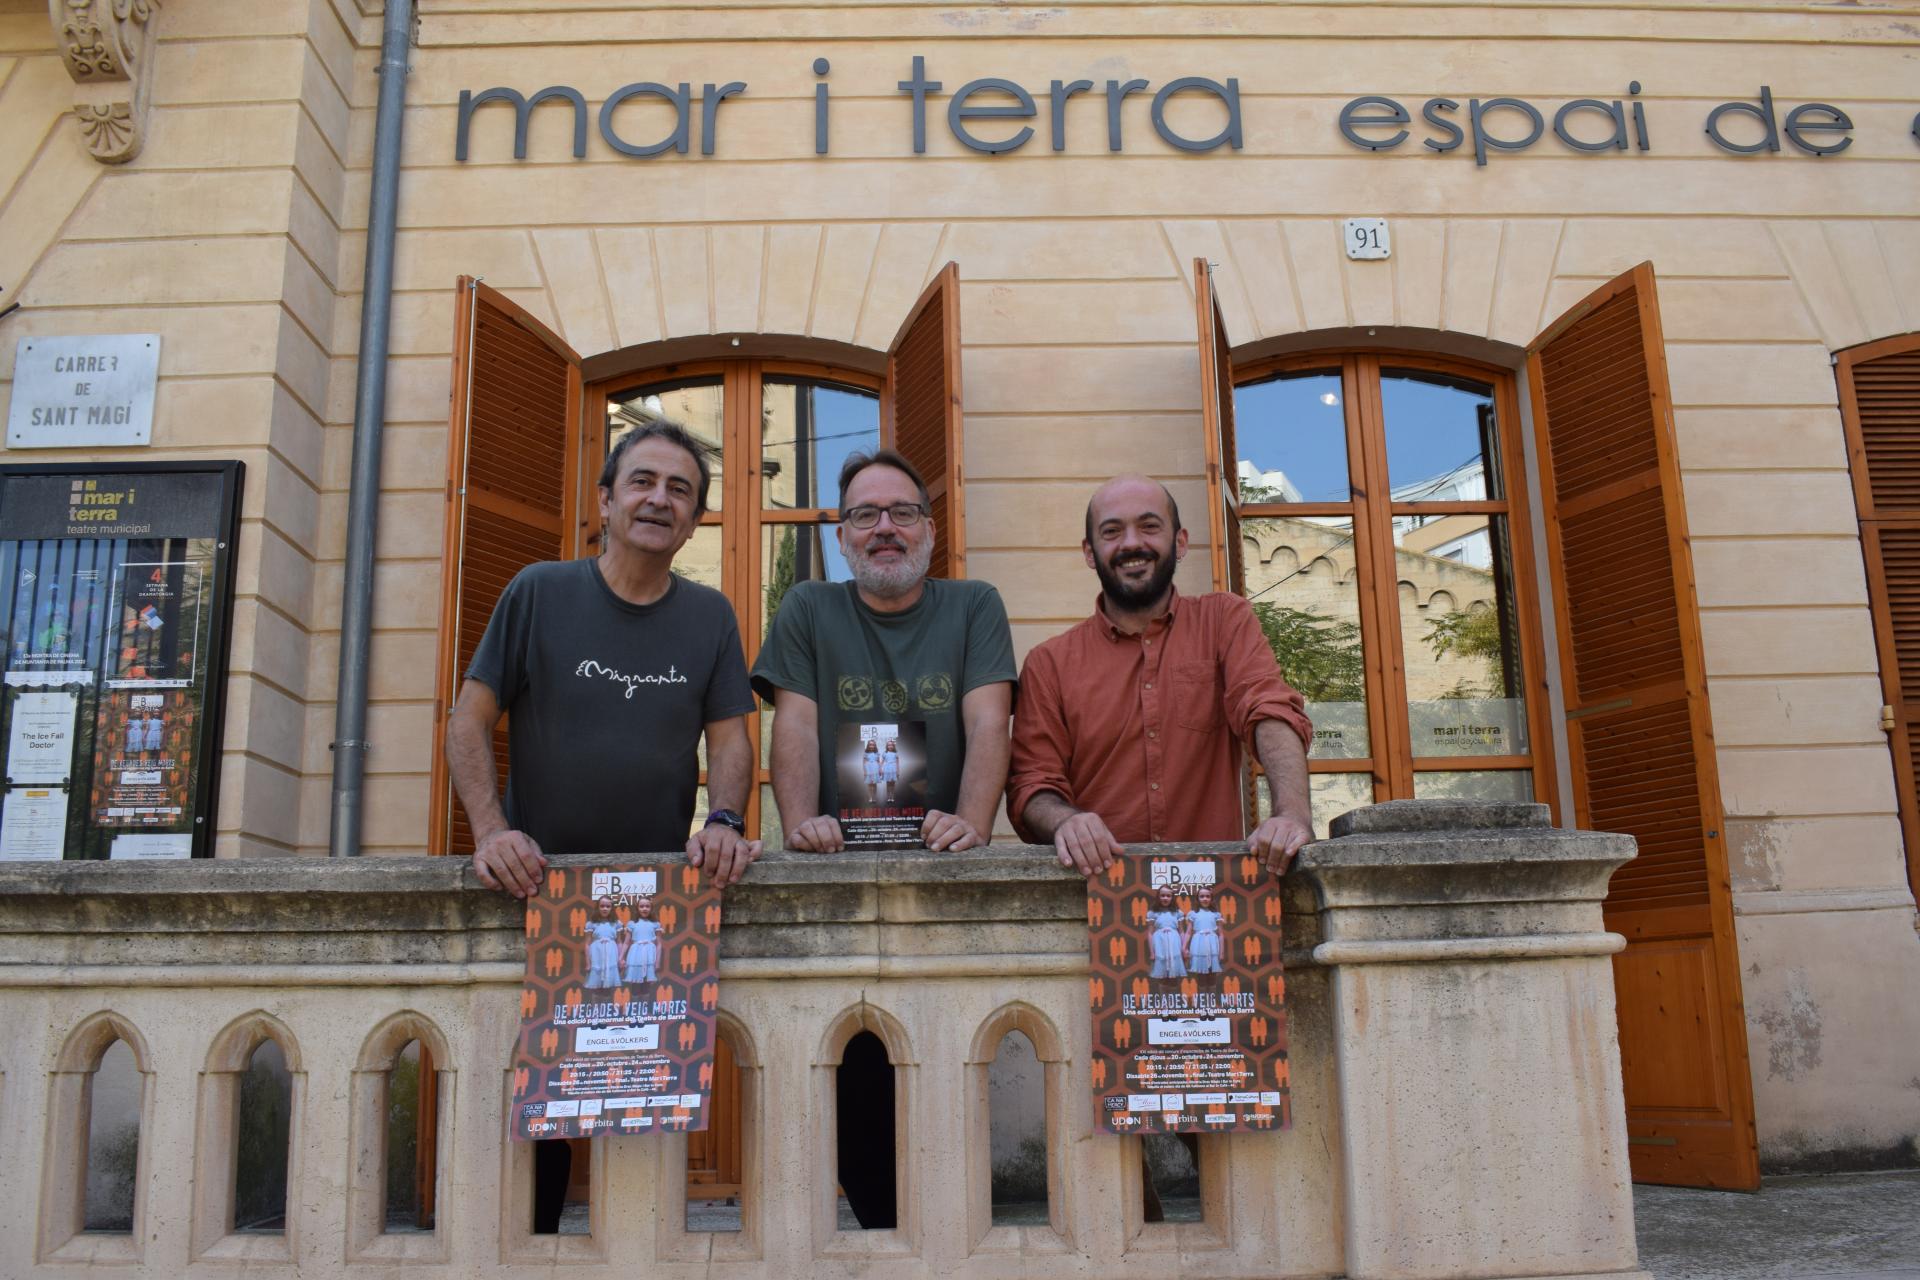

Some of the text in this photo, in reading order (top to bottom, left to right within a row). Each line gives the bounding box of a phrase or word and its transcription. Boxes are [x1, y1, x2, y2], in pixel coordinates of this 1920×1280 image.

[455, 81, 748, 161] mar
[813, 57, 831, 155] i
[897, 55, 1244, 155] terra
[1339, 80, 1650, 166] espai
[1706, 86, 1854, 155] de
[1354, 227, 1382, 250] 91
[55, 356, 118, 373] CARRER
[75, 382, 92, 396] DE
[31, 407, 79, 426] SANT
[83, 488, 136, 505] mar i
[69, 506, 118, 522] terra
[67, 524, 151, 535] teatre municipal
[150, 568, 161, 583] 4
[22, 732, 64, 740] The Ice Fall
[1433, 726, 1459, 736] mar
[1468, 725, 1501, 735] terra
[29, 741, 55, 749] Doctor
[1123, 992, 1255, 1009] DE VEGADES VEIG MORTS
[554, 1000, 687, 1019] DE VEGADES VEIG MORTS
[528, 1122, 557, 1132] UDON
[1111, 1116, 1141, 1125] UDON
